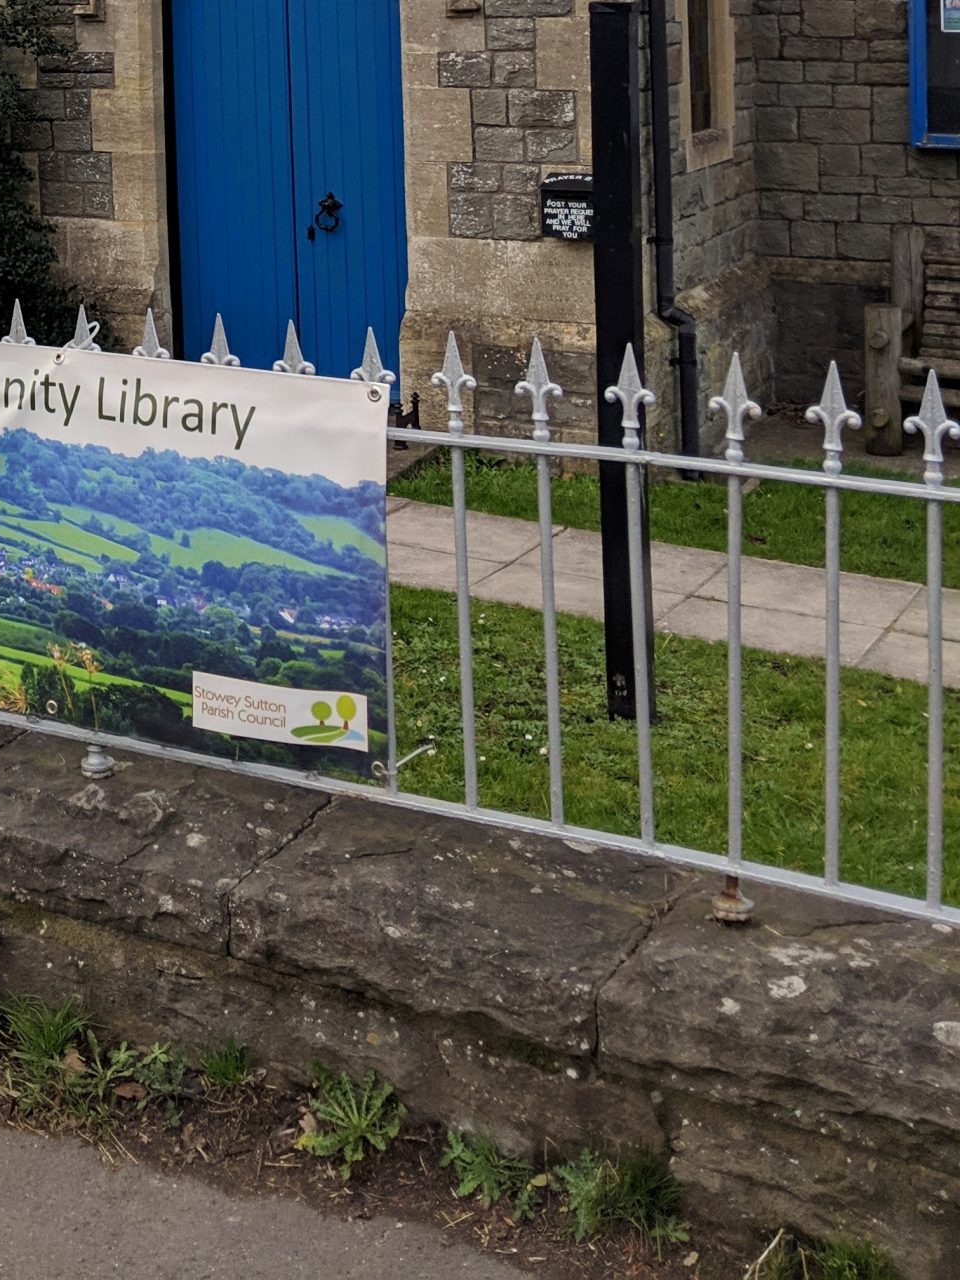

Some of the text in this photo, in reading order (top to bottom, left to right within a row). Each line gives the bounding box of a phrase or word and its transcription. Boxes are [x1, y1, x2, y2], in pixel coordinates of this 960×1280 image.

[544, 175, 582, 184] PRAYER
[546, 200, 565, 208] POST
[574, 219, 591, 227] WILL
[552, 224, 587, 233] PRAY FOR
[562, 231, 578, 239] YOU
[97, 376, 257, 450] Library
[194, 685, 287, 714] Stowey Sutton
[201, 702, 287, 729] Parish Council
